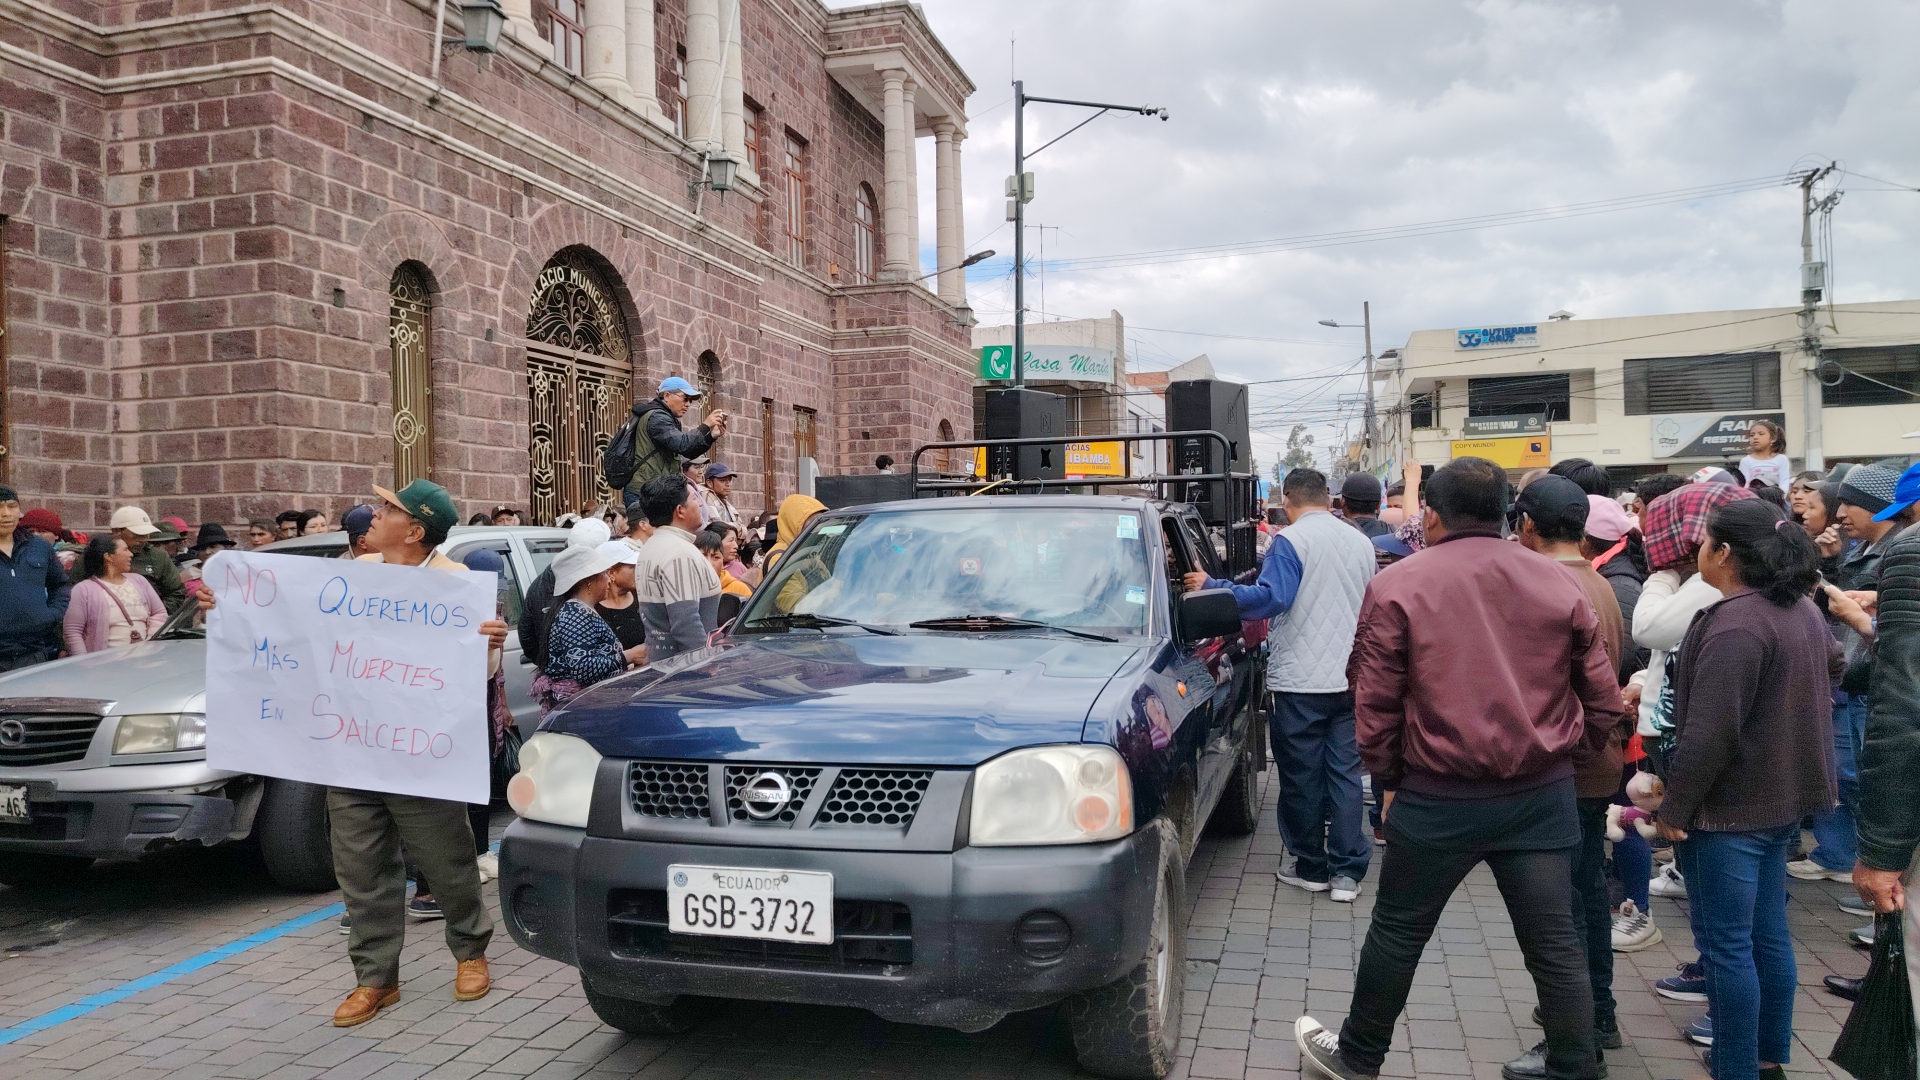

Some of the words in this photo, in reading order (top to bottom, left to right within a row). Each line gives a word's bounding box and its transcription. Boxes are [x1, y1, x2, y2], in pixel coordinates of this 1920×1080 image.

[528, 267, 565, 315] ALACIO
[570, 269, 615, 336] MUNICIPAL
[1482, 326, 1537, 337] GUTIERREZ
[1489, 334, 1515, 343] CRUZ
[1066, 453, 1110, 464] IBAMBA
[223, 562, 277, 607] NO
[318, 576, 469, 628] QUEREMOS
[329, 640, 445, 691] MUERTES
[260, 698, 284, 721] EN
[308, 693, 453, 759] SALCEDO
[743, 791, 785, 800] NISSAN
[718, 875, 782, 891] ECUADOR
[683, 892, 816, 937] GSB-3732
